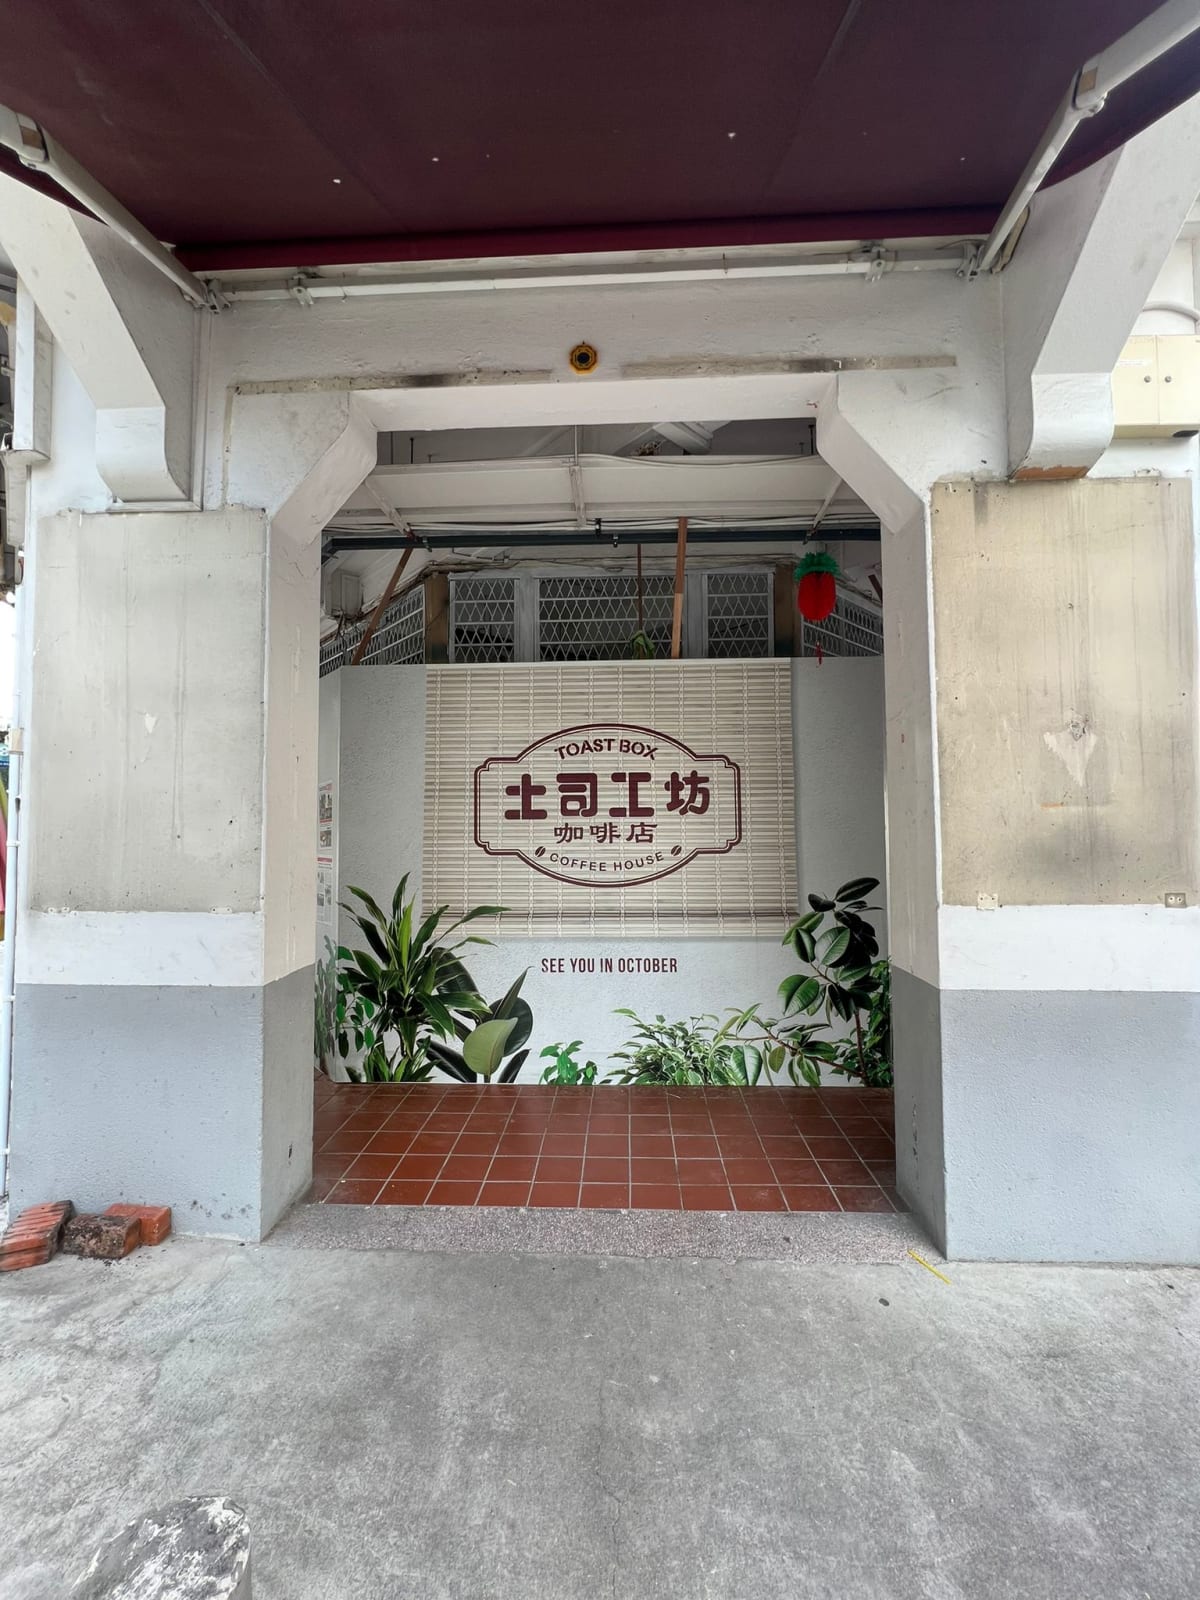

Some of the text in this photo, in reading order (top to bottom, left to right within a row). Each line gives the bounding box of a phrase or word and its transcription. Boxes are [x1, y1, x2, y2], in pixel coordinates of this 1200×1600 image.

[554, 738, 659, 761] TOAST BOX
[504, 771, 710, 820] 土司工坊
[554, 822, 658, 844] 咖啡店
[550, 852, 665, 872] COFFEE HOUSE
[541, 958, 678, 973] SEE YOU IN OCTOBER
